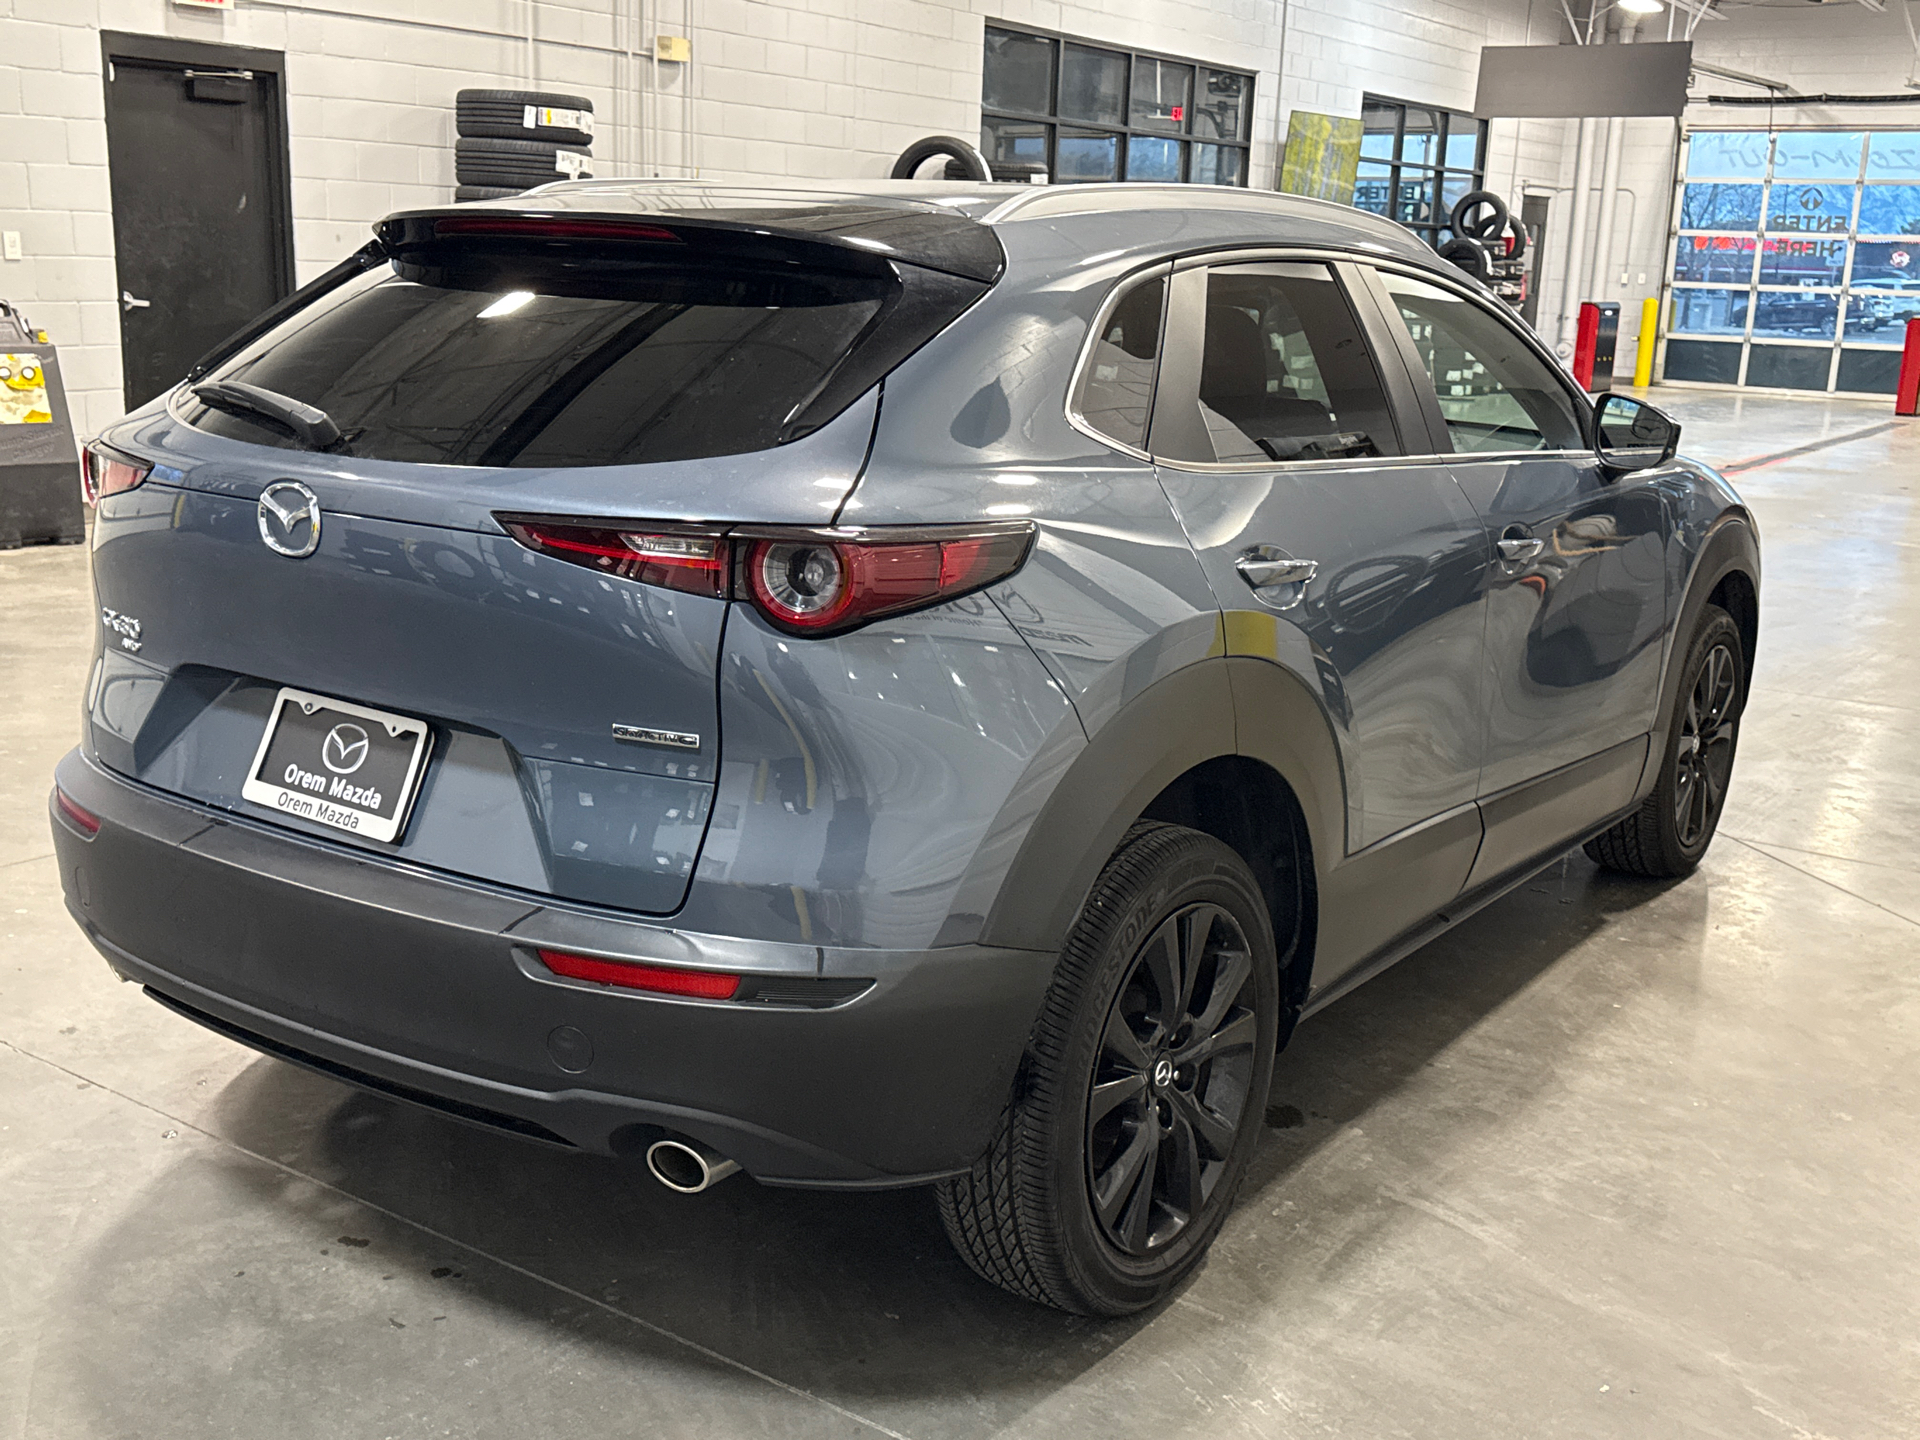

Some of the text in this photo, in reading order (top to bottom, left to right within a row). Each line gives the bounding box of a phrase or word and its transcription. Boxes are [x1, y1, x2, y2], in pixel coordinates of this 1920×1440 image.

[284, 763, 382, 809] Orem Mazda
[277, 791, 360, 829] Orem Mazda
